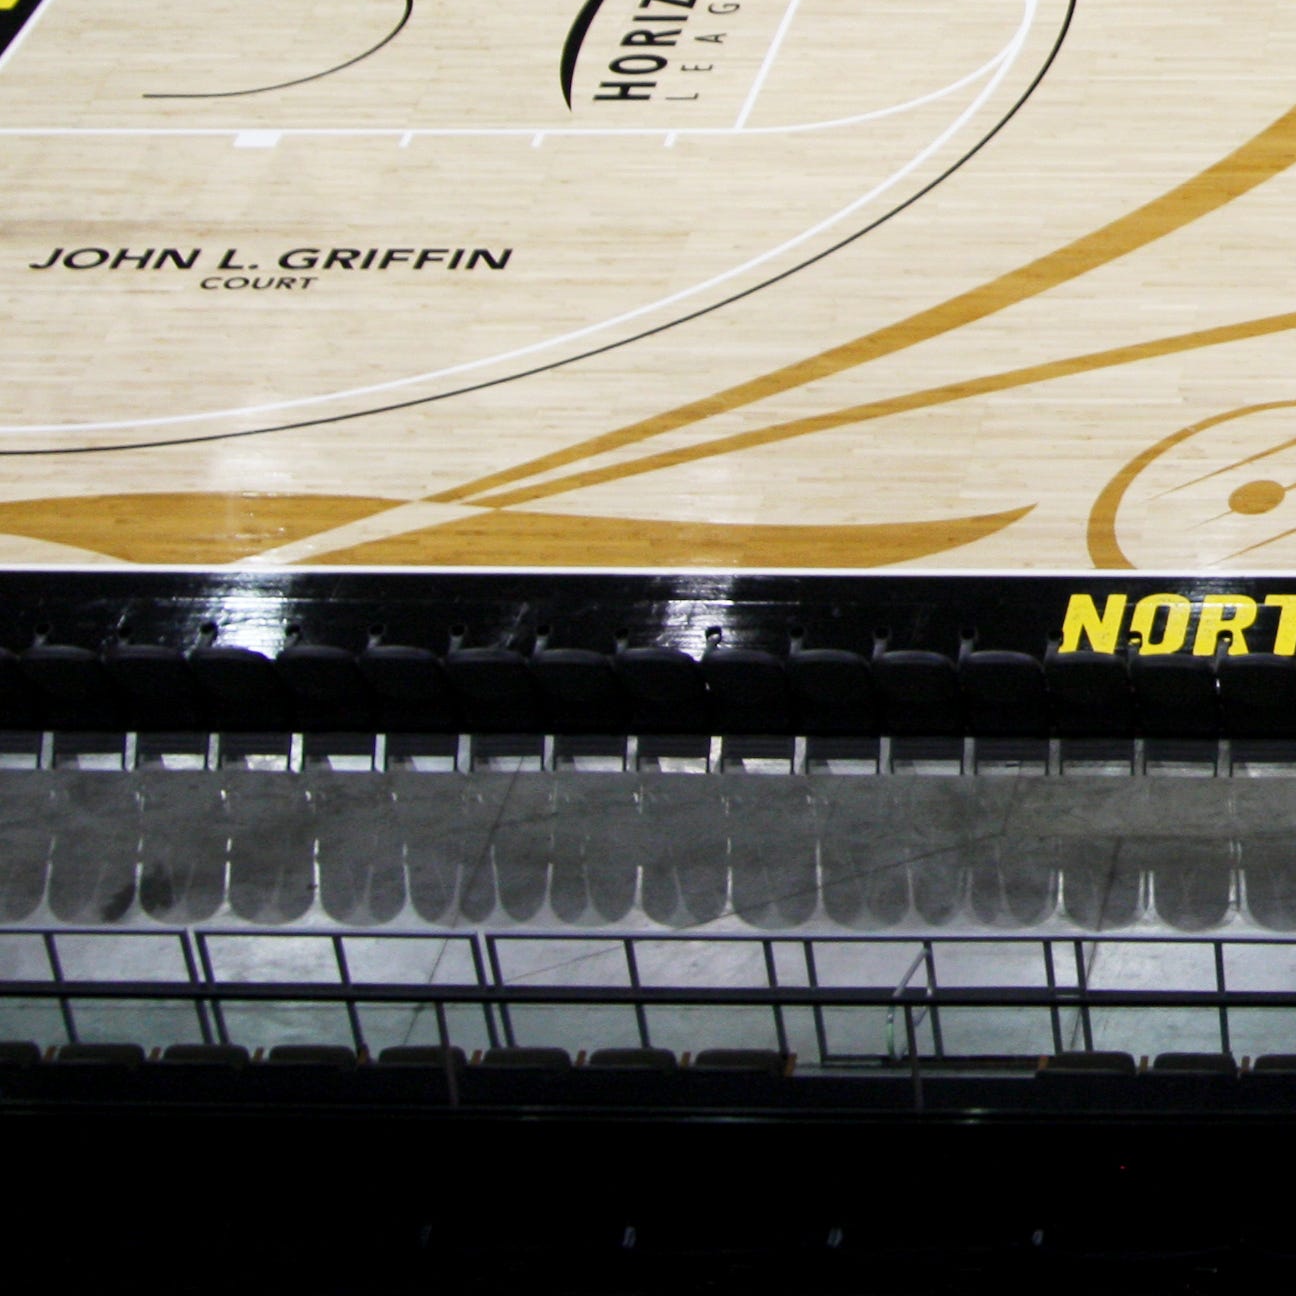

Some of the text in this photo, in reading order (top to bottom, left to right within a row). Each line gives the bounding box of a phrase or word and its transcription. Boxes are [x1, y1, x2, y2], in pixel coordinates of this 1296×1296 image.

[28, 247, 514, 271] JOHN L. GRIFFIN
[200, 276, 319, 291] COURT
